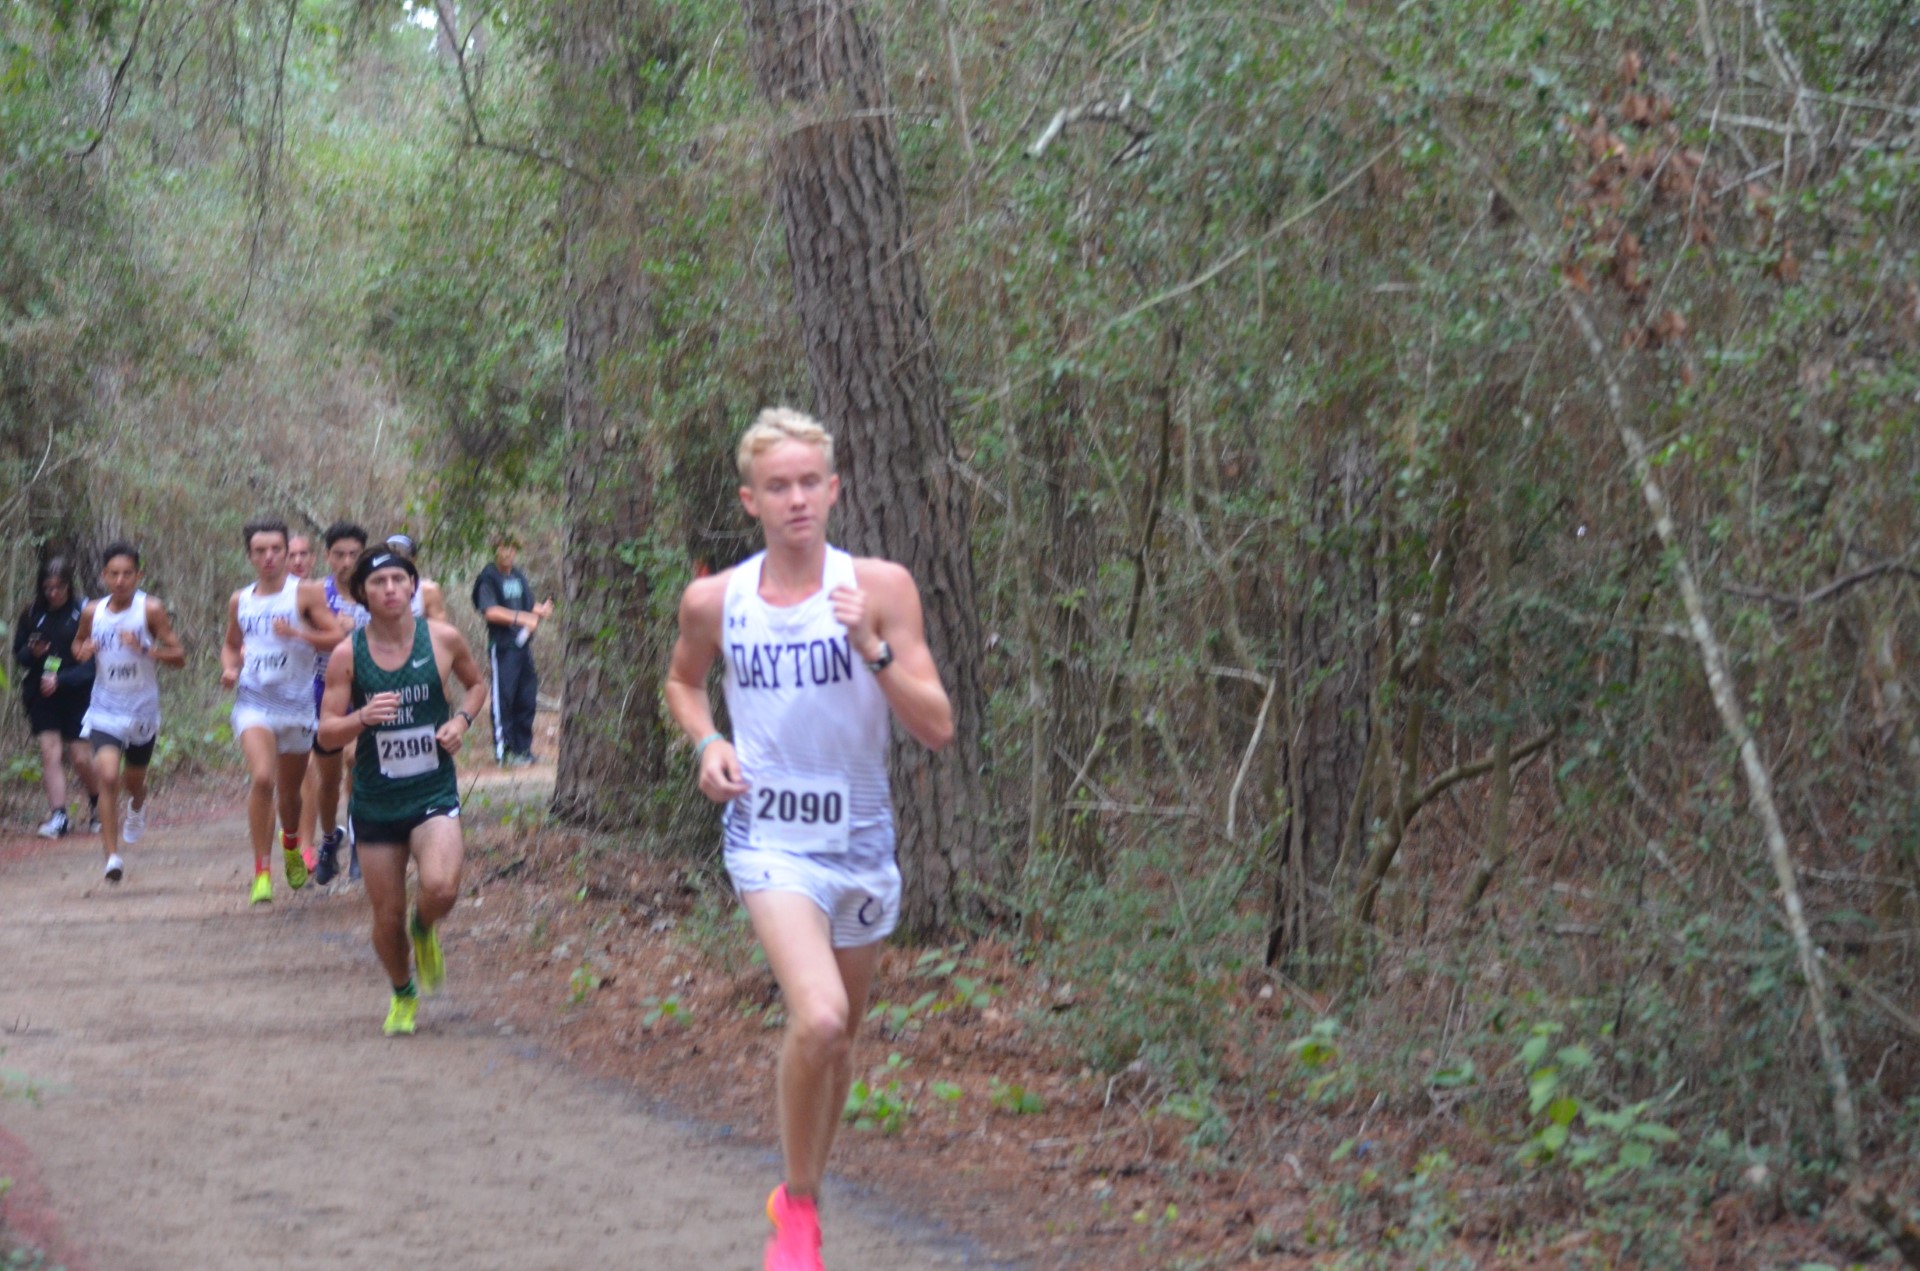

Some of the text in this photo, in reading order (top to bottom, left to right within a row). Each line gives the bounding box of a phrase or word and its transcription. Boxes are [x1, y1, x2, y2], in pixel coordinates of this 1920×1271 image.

[731, 634, 853, 689] DAYTON
[381, 735, 433, 760] 2396
[757, 787, 842, 824] 2090
